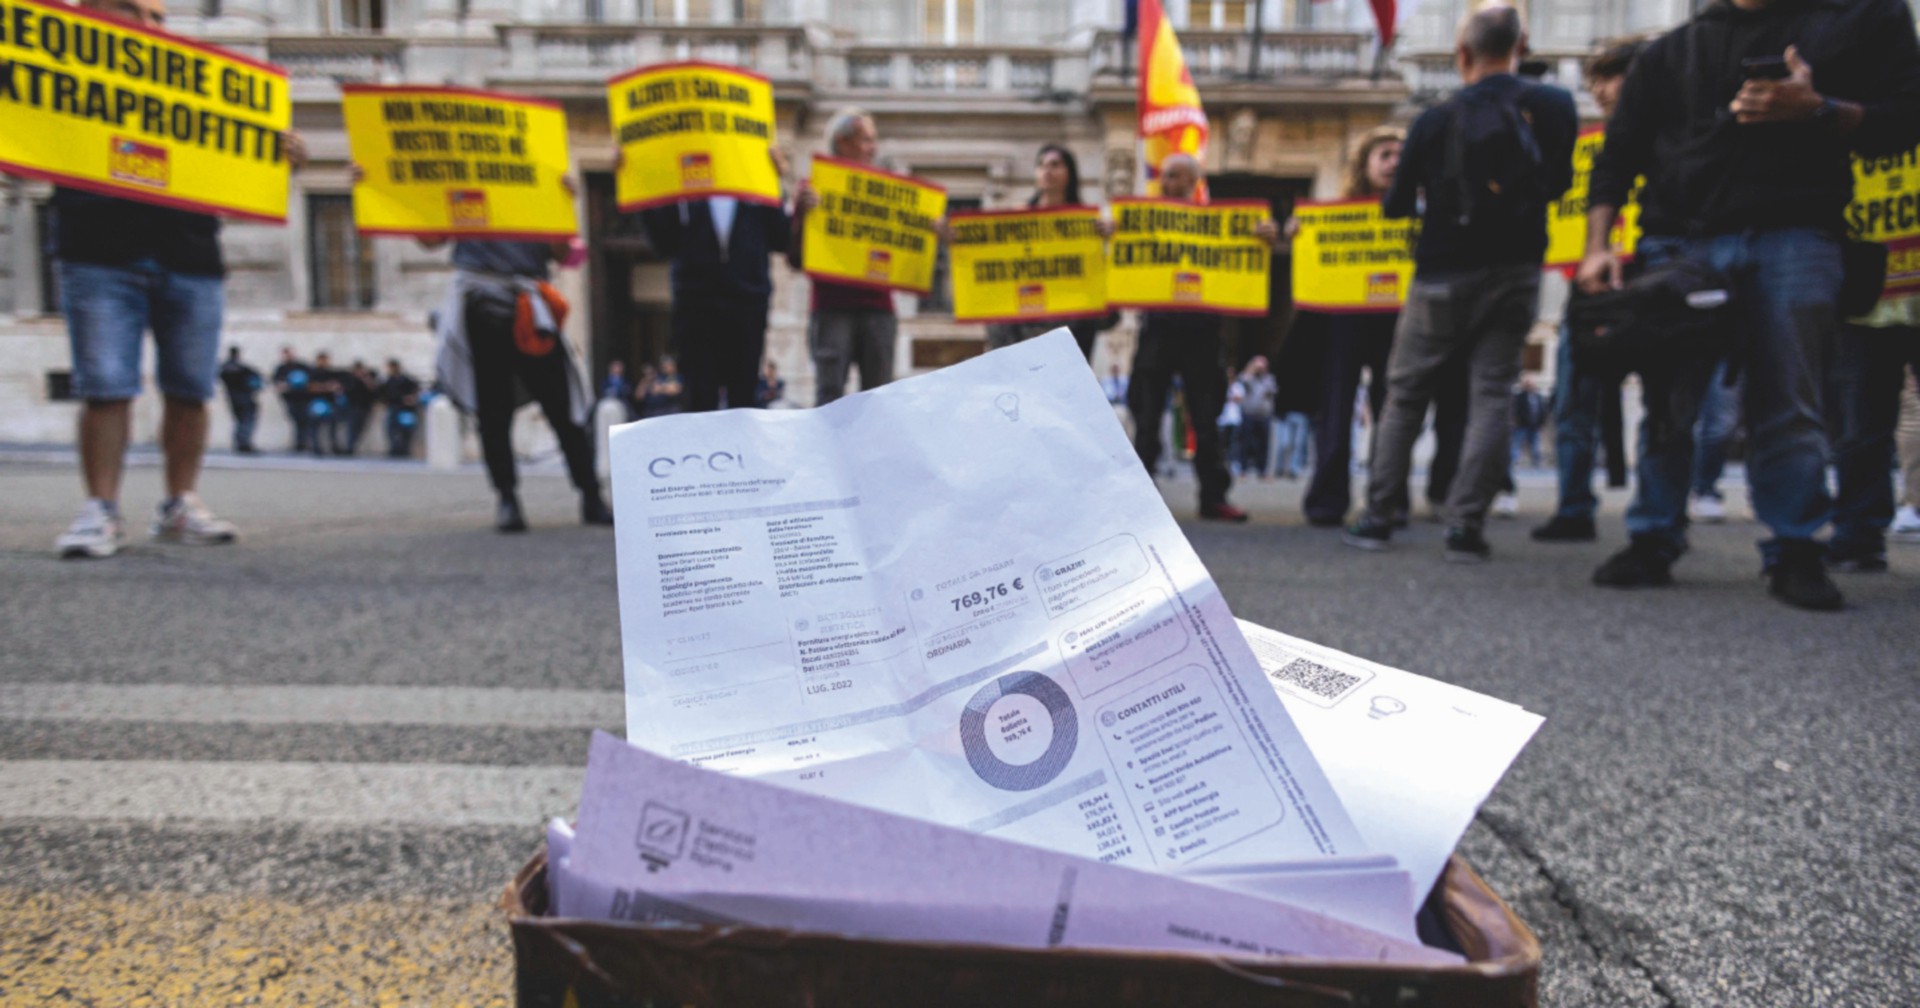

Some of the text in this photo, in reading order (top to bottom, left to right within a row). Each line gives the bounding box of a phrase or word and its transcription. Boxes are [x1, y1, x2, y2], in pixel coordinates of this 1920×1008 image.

[0, 3, 271, 112] EQUISIRE GLI
[952, 583, 1008, 611] 769,76
[1012, 578, 1024, 590] €
[831, 680, 852, 690] 2022
[1118, 683, 1186, 720] CONTATTI UTILI
